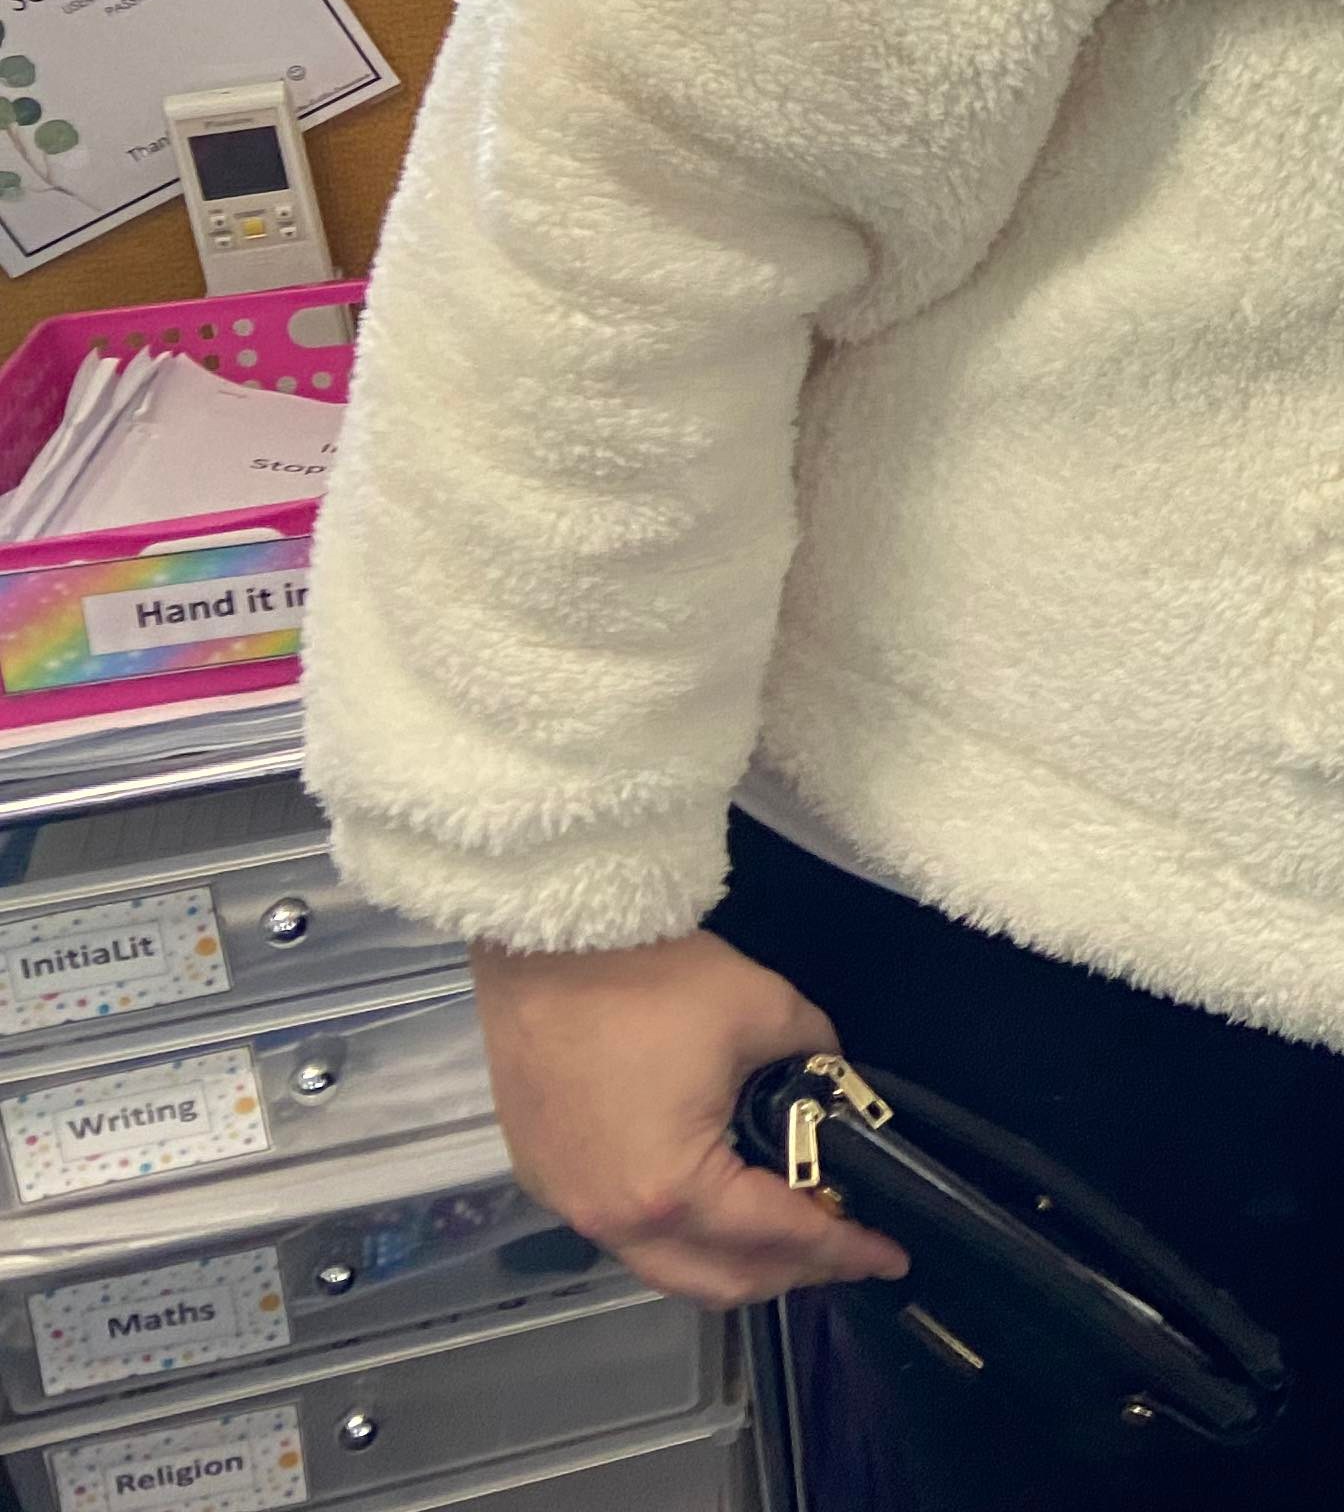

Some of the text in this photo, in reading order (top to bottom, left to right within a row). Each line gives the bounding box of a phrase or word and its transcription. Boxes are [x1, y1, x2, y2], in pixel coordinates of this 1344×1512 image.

[136, 589, 235, 628] Hand
[246, 588, 273, 613] it
[20, 936, 155, 979] InitiaLit
[67, 1099, 198, 1140] Writing
[107, 1301, 216, 1338] Maths
[116, 1454, 243, 1496] Religion
